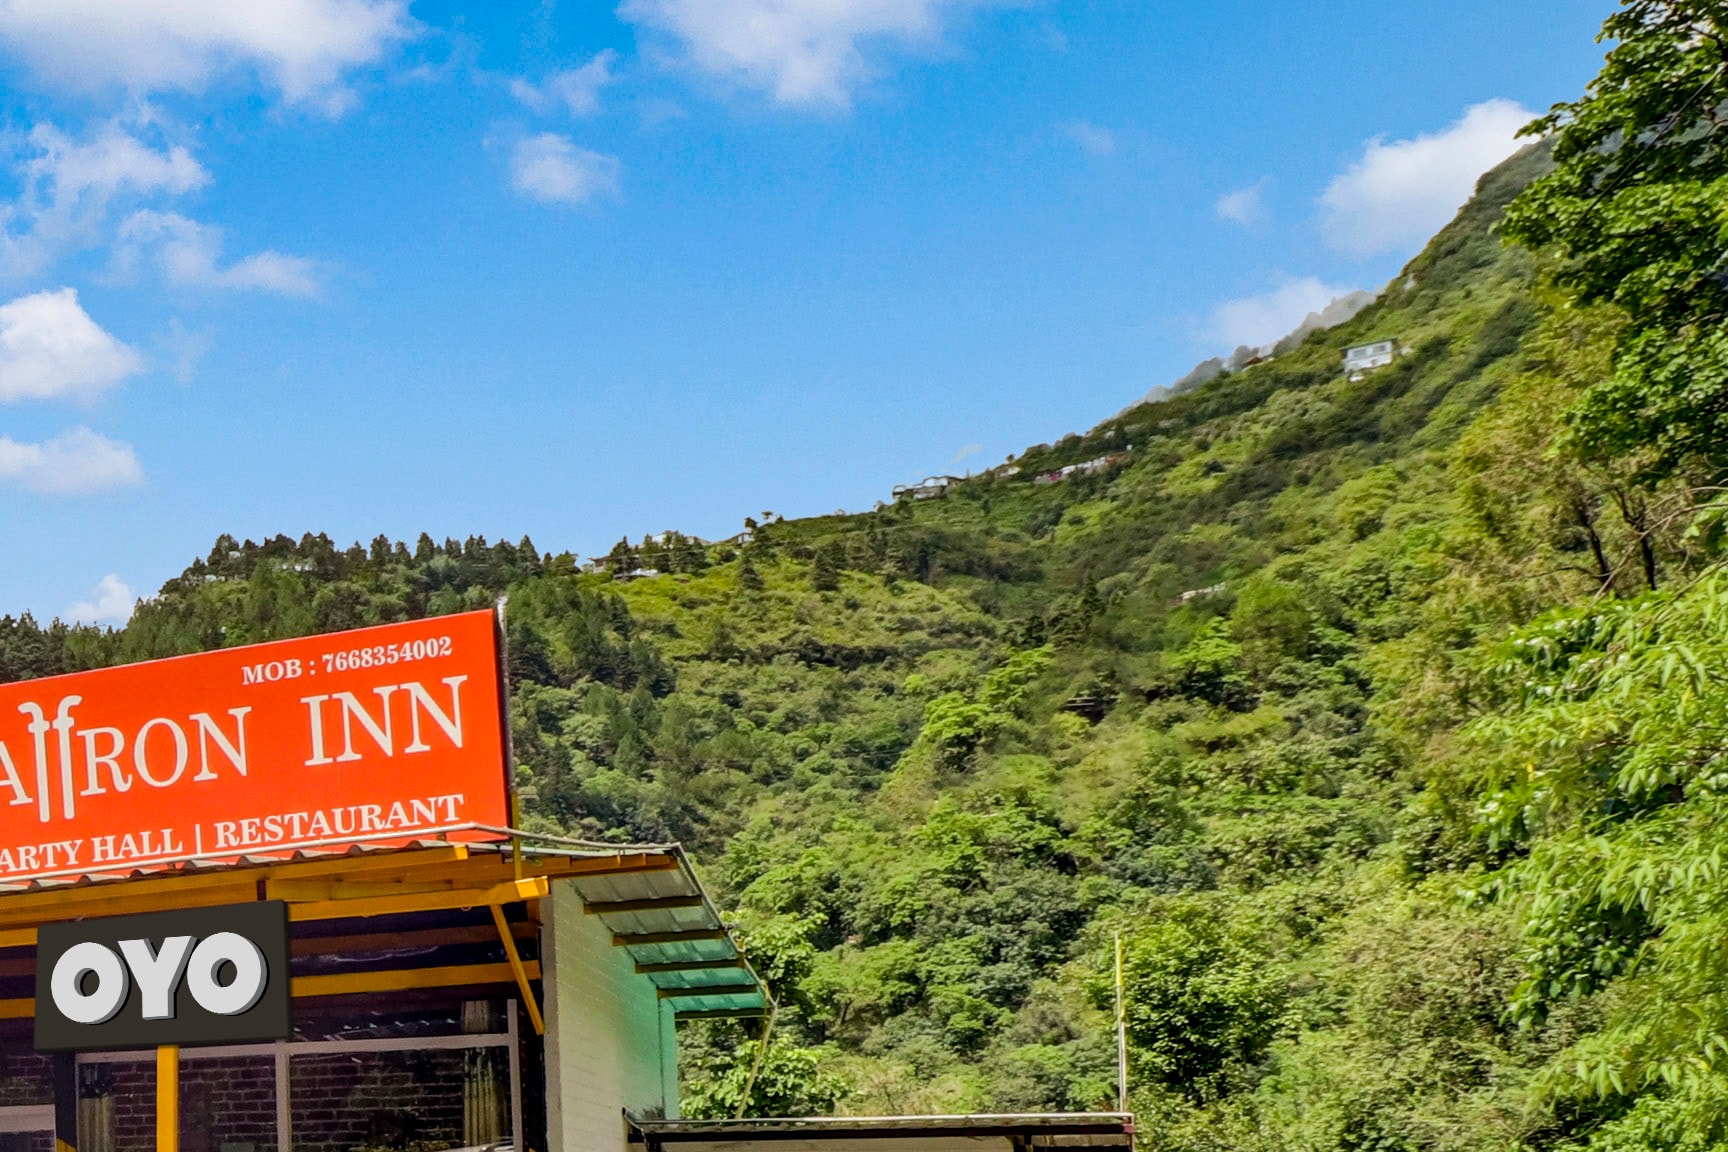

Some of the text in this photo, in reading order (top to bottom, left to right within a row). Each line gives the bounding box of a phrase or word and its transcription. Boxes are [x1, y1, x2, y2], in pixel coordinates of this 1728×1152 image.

[241, 659, 303, 686] MOB
[321, 636, 453, 673] 7668354002
[300, 674, 468, 767] INN
[92, 828, 183, 863] HALL
[214, 793, 464, 848] RESTAURANT
[51, 931, 269, 1026] OYO
